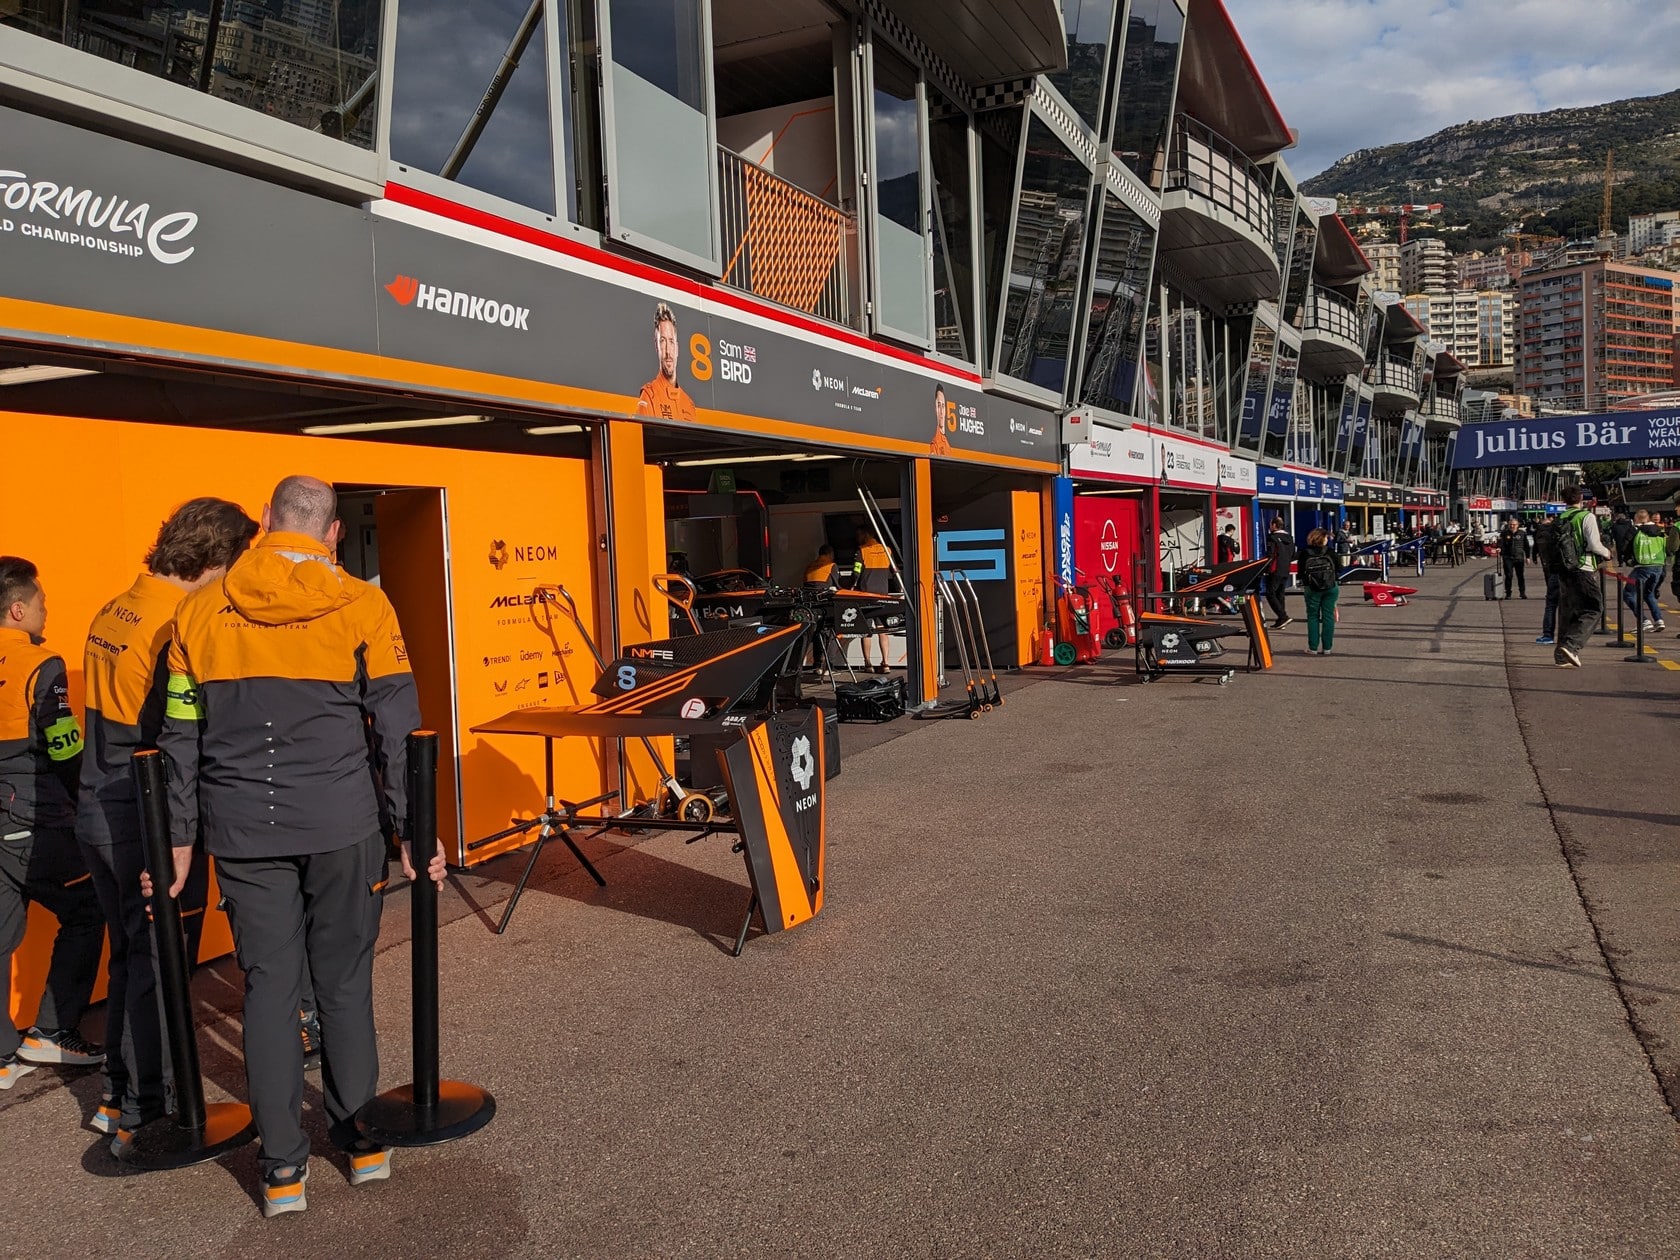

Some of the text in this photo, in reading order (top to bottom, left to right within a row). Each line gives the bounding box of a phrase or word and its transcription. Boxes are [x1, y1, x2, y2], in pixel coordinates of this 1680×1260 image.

[20, 222, 144, 258] CHAMPIONSHIP
[689, 331, 713, 381] 8
[719, 339, 742, 360] Sam
[720, 358, 752, 384] BIRD
[823, 376, 879, 400] NEOM McLaren
[946, 401, 957, 433] 5
[960, 418, 985, 436] HUGHES
[1475, 421, 1637, 459] Julius Bär
[1167, 451, 1174, 469] 23
[1221, 464, 1226, 479] 22
[515, 546, 557, 561] NEOM
[1101, 541, 1119, 551] NISSAN
[1188, 574, 1198, 584] 5
[113, 606, 142, 626] NEOM
[498, 617, 531, 626] FORMULA
[88, 633, 120, 656] McLaren
[631, 647, 673, 660] NMFE
[1197, 642, 1210, 651] FIA
[490, 655, 510, 664] TREND
[617, 665, 637, 690] 8
[686, 700, 701, 718] F
[52, 729, 80, 750] S10
[795, 793, 817, 812] NEOM
